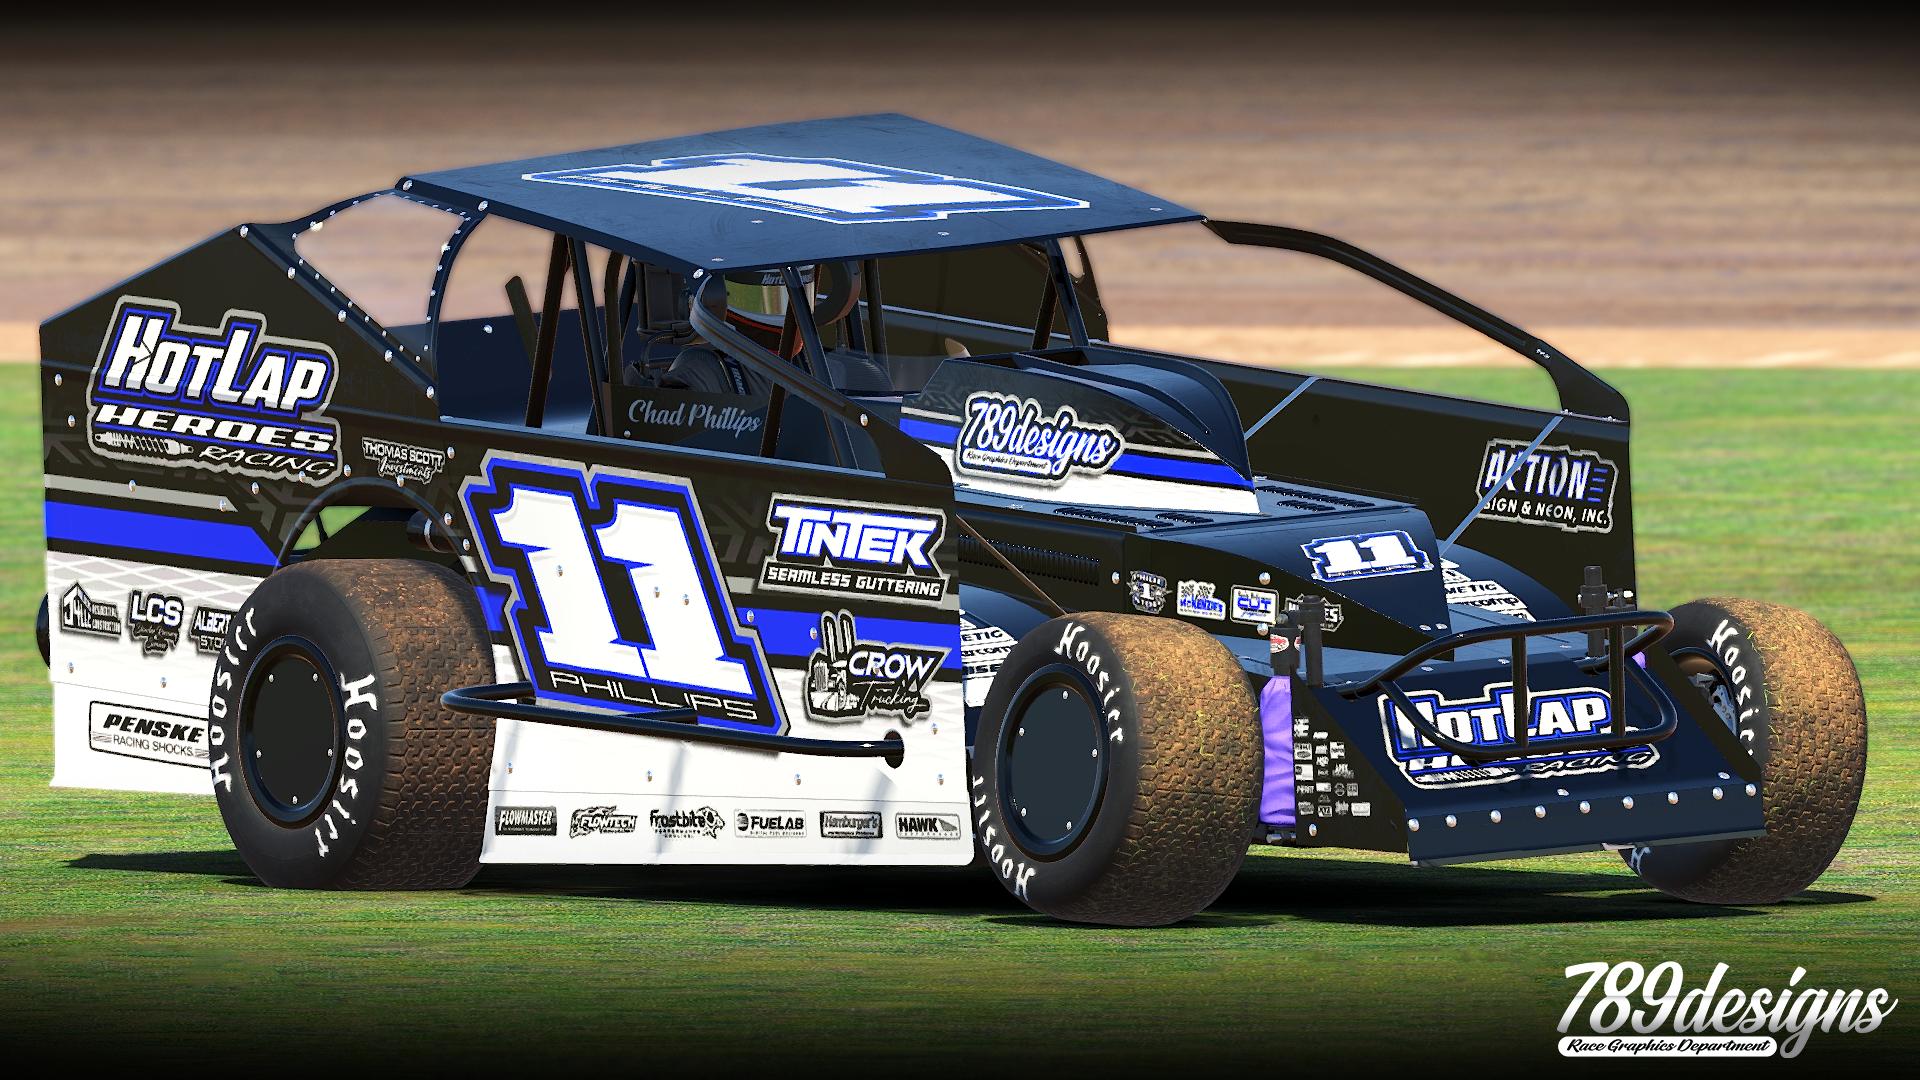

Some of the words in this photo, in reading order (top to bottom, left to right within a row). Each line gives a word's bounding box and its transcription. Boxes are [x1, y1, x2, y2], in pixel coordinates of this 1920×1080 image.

[95, 404, 334, 453] HEROES
[628, 400, 685, 425] Chad
[687, 402, 763, 438] Phillips
[363, 441, 408, 460] THOMAS
[409, 449, 443, 467] SCOTT
[964, 401, 1117, 476] 789designs
[198, 445, 335, 477] RACING
[1484, 449, 1591, 500] AKTION
[1484, 497, 1518, 514] SIGN
[1521, 500, 1532, 515] &
[1535, 502, 1578, 522] NEON,
[1581, 510, 1608, 526] INC.
[773, 504, 938, 569] TINTEK
[1313, 535, 1418, 574] 11
[493, 486, 754, 695] 11
[767, 566, 852, 588] SEAMLESS
[856, 575, 941, 597] GUTTERING
[131, 594, 183, 627] LCS
[1237, 596, 1272, 611] CUT
[849, 651, 937, 680] CROW
[550, 670, 758, 720] PHILLIPS
[853, 680, 928, 713] Trucking
[1054, 621, 1124, 744] Hoosier
[103, 713, 205, 744] PENSKE
[113, 734, 150, 751] RACING
[152, 741, 194, 757] SHOCKS
[1523, 751, 1652, 772] RACING
[498, 809, 553, 831] FLOWMASTER
[580, 815, 637, 830] FLOWTECH
[750, 816, 804, 830] FUELAB
[825, 814, 878, 830] Hamburger's
[899, 817, 938, 832] HAWK
